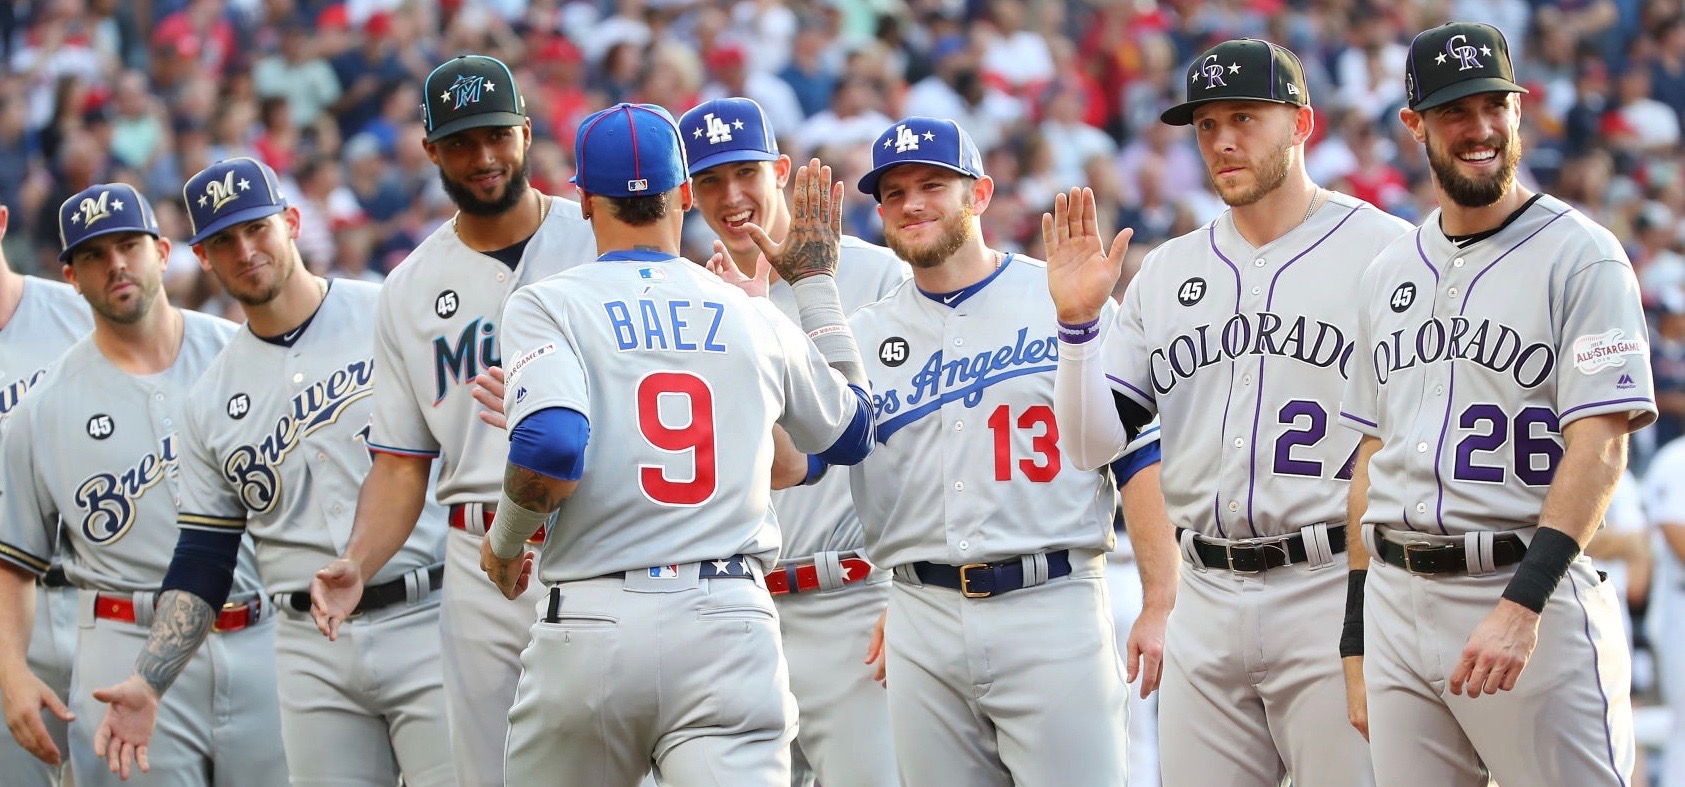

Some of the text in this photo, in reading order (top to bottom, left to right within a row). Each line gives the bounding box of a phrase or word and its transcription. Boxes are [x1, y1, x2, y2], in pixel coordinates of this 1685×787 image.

[704, 113, 733, 144] LA
[895, 124, 919, 153] LA
[80, 190, 111, 228] M
[206, 170, 239, 211] M
[437, 293, 457, 315] 45
[1180, 282, 1203, 301] 45
[1392, 287, 1413, 308] 45
[604, 286, 727, 353] BÁEZ
[432, 316, 501, 408] Mi
[882, 342, 905, 361] 45
[1374, 317, 1556, 388] OLORADO
[229, 395, 248, 416] 45
[871, 380, 900, 420] os
[89, 416, 111, 438] 45
[223, 357, 373, 514] Brewer
[635, 370, 719, 507] 9
[988, 404, 1062, 482] 13
[1453, 403, 1565, 486] 26
